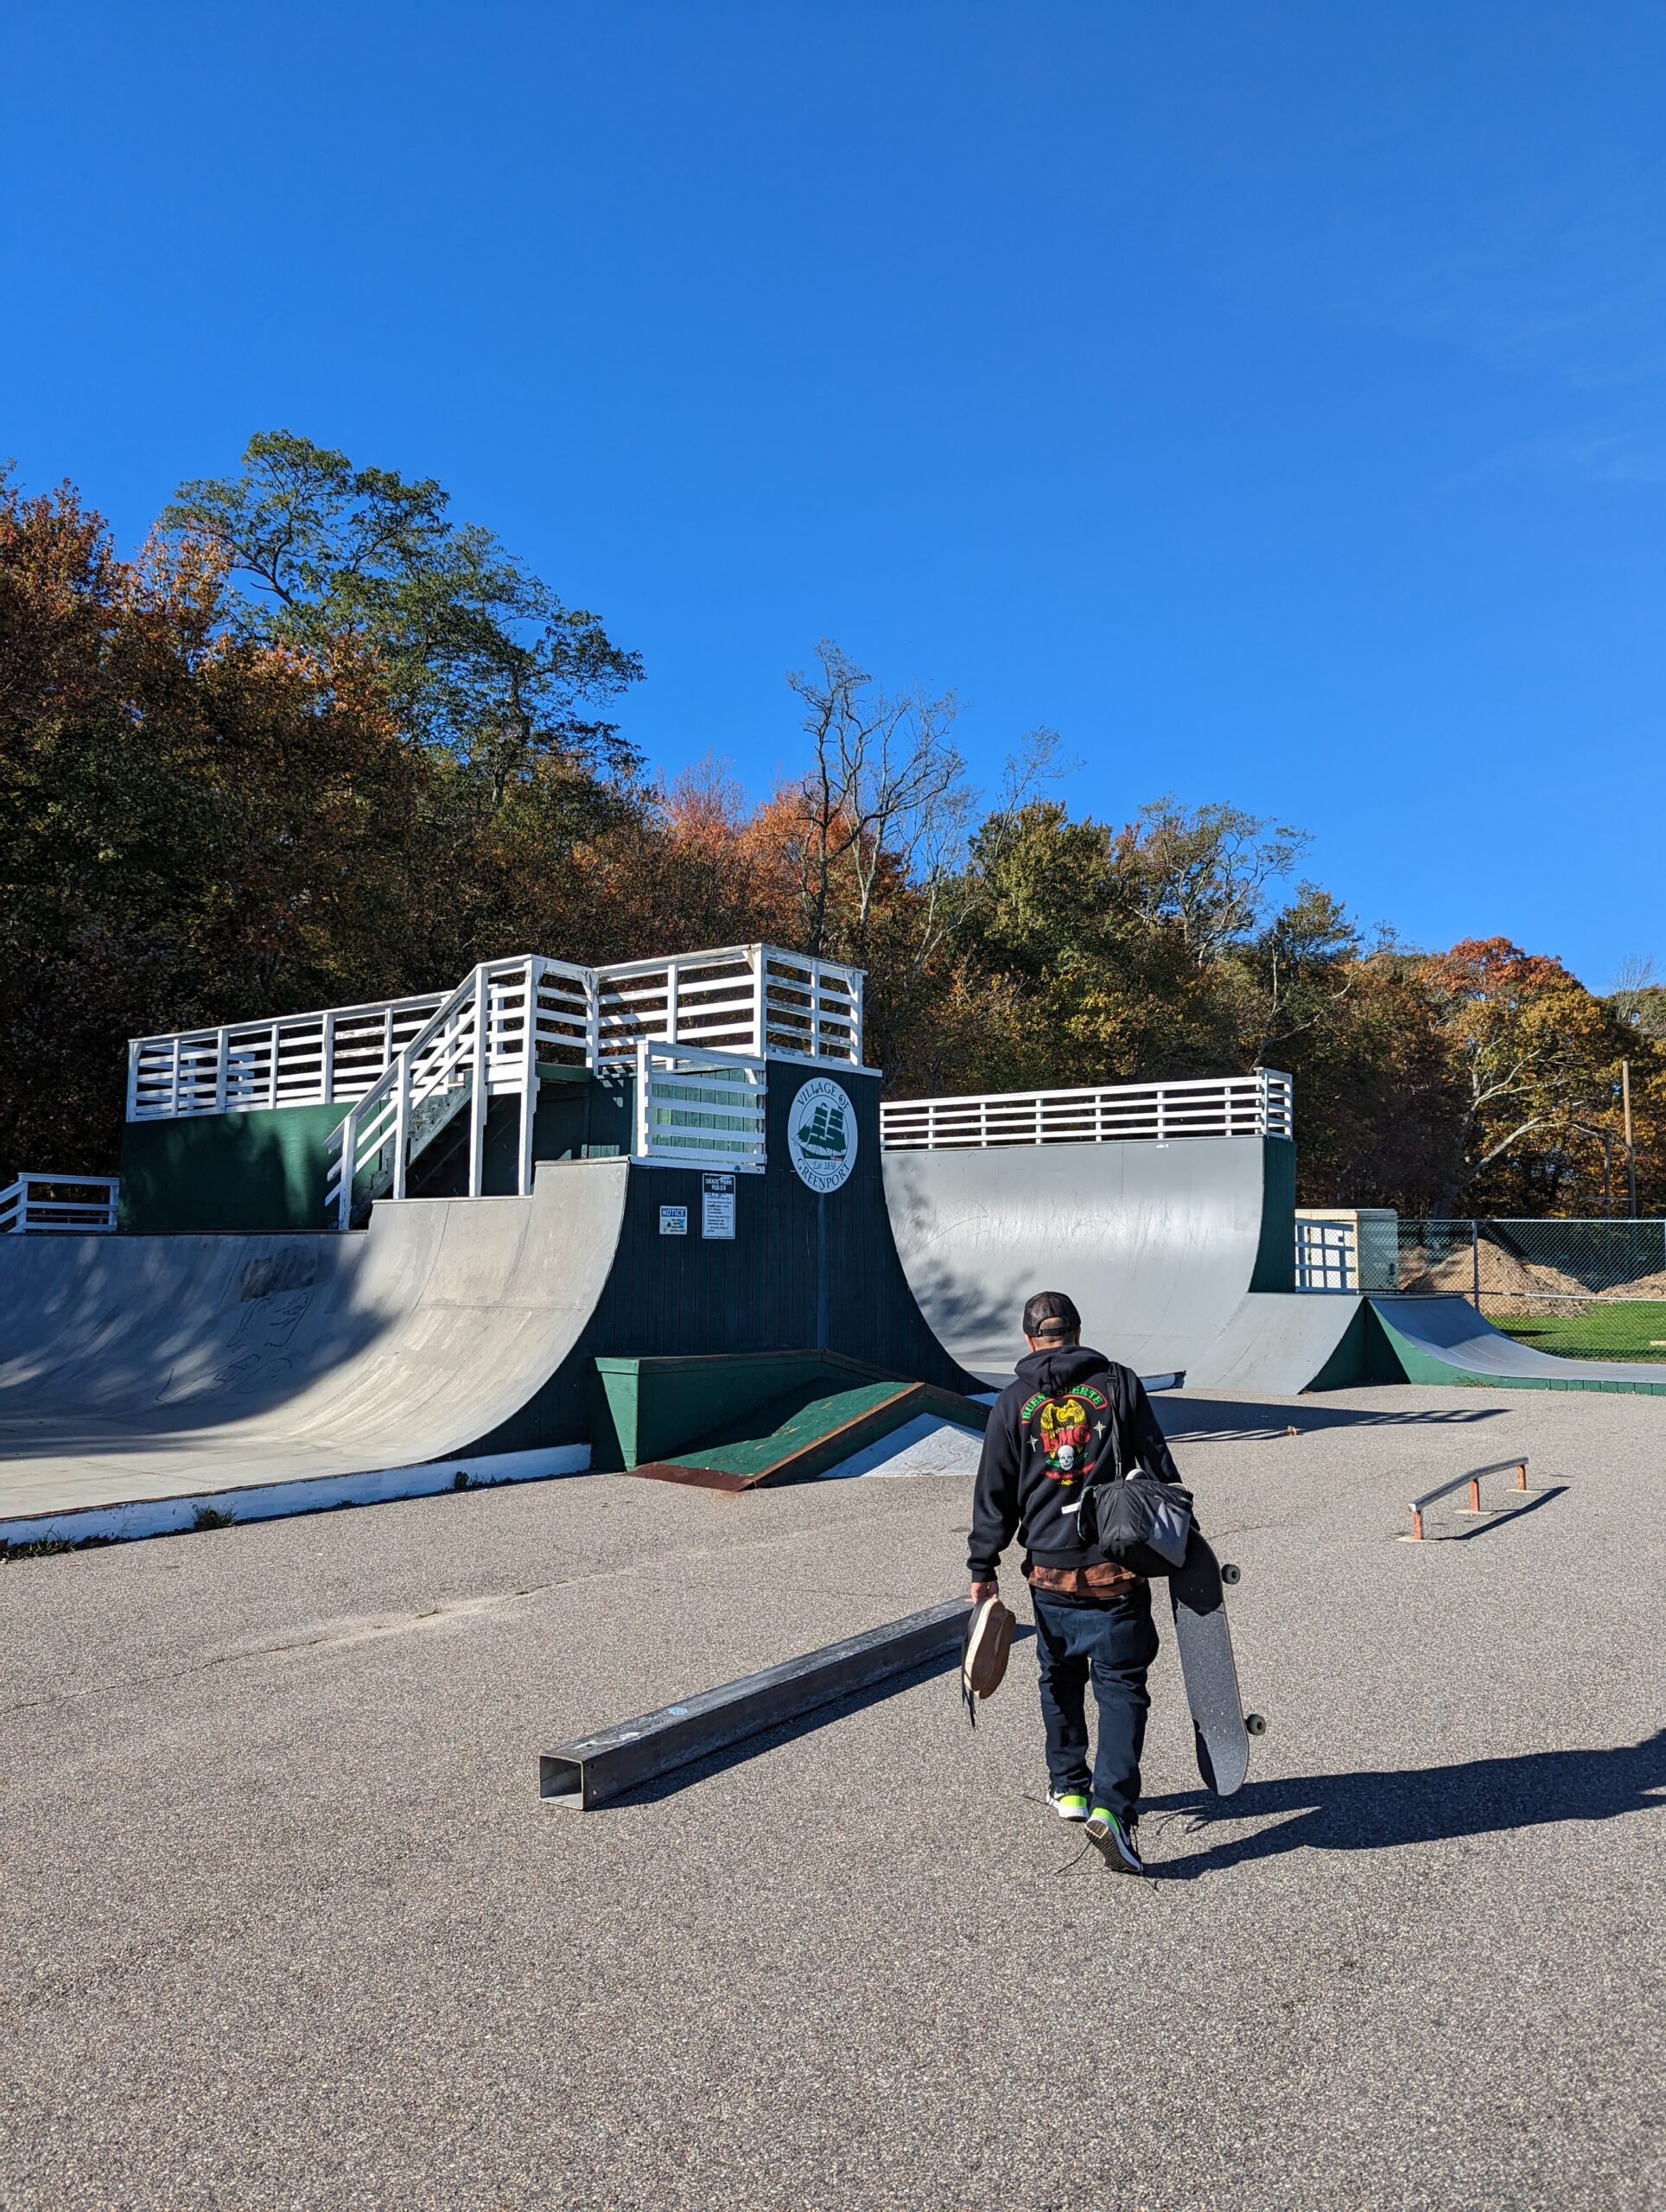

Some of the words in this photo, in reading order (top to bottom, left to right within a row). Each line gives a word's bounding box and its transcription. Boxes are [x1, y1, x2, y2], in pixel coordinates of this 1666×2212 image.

[797, 1082, 837, 1106] VILLAGE
[839, 1094, 850, 1110] OF
[798, 1159, 849, 1190] GREENPORT
[1022, 1393, 1049, 1420] BUEN
